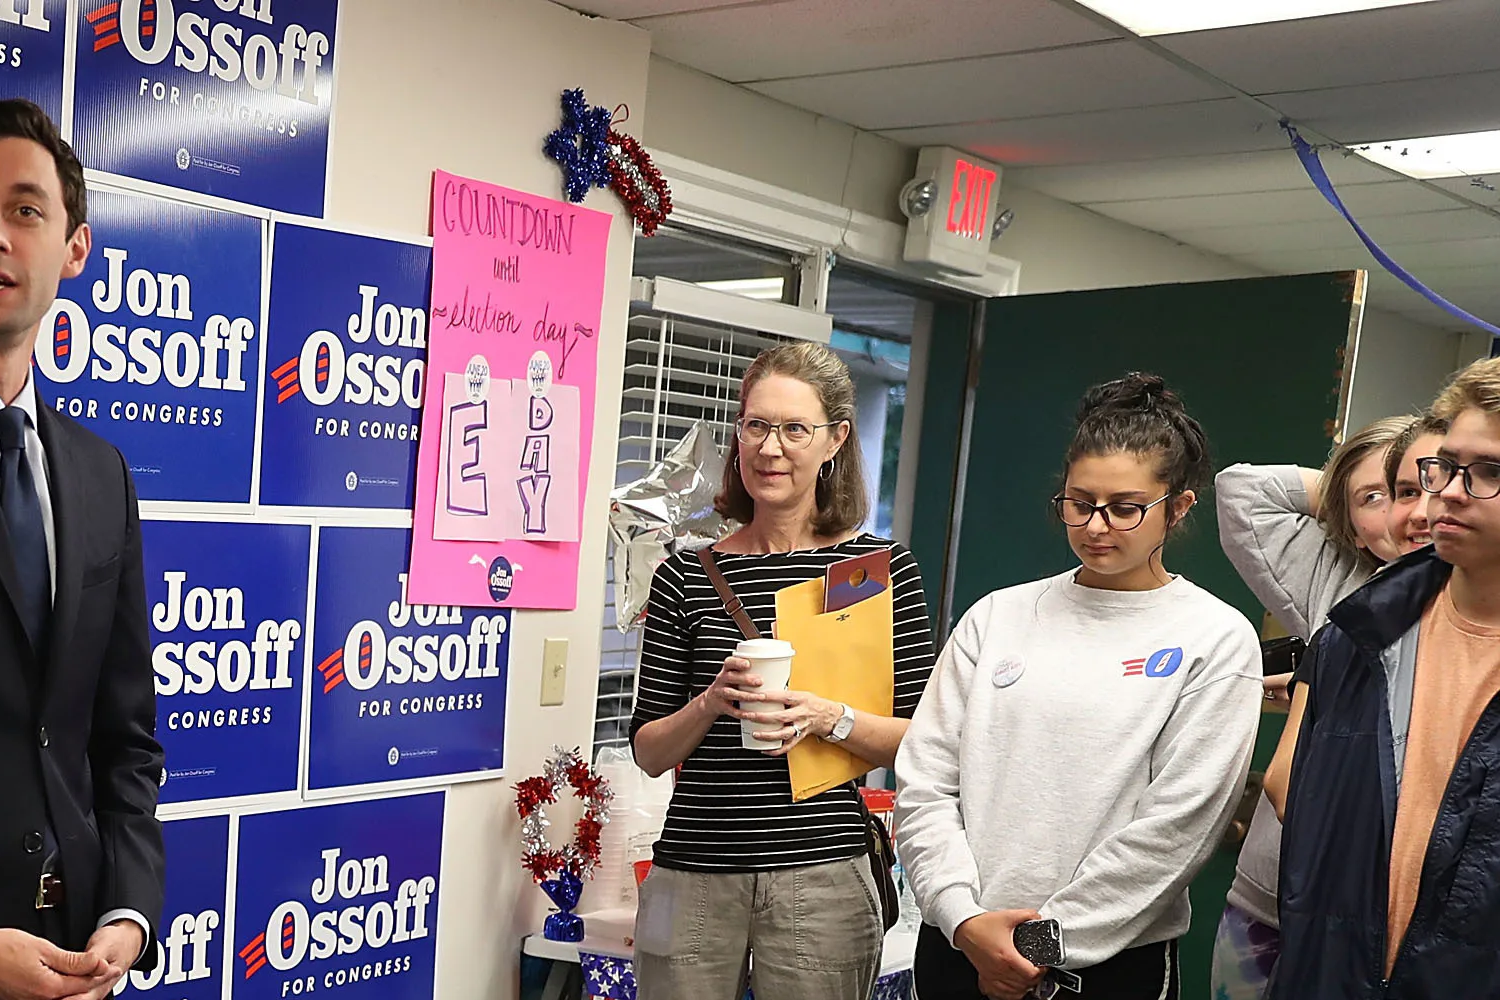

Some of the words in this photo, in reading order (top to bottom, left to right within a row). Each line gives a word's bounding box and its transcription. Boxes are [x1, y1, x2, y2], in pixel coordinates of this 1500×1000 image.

[120, 0, 329, 105] Ossoff
[139, 78, 181, 106] FOR
[192, 94, 298, 138] CONGRESS
[443, 180, 575, 255] COUNTDOWN
[946, 158, 997, 241] EXIT
[92, 247, 193, 321] Jon
[493, 256, 520, 283] until
[34, 298, 255, 392] Ossoff
[347, 284, 427, 349] Jon
[446, 285, 523, 334] election
[533, 301, 578, 380] day
[299, 330, 428, 409] Osso
[55, 397, 99, 419] FOR
[110, 401, 223, 427] CONGRESS
[315, 417, 350, 437] FOR
[359, 420, 418, 441] CONGR
[447, 400, 488, 516] E
[152, 571, 246, 632] Jon
[490, 573, 513, 588] Ossoff
[151, 619, 301, 696] ssoff
[343, 615, 507, 691] Ossoff
[168, 706, 272, 730] CONGRESS
[358, 700, 392, 718] FOR
[400, 693, 483, 715] CONGRESS
[311, 847, 389, 904] Jon
[265, 876, 436, 971] Ossoff
[281, 976, 315, 998] FOR
[324, 955, 411, 988] CONGRESS
